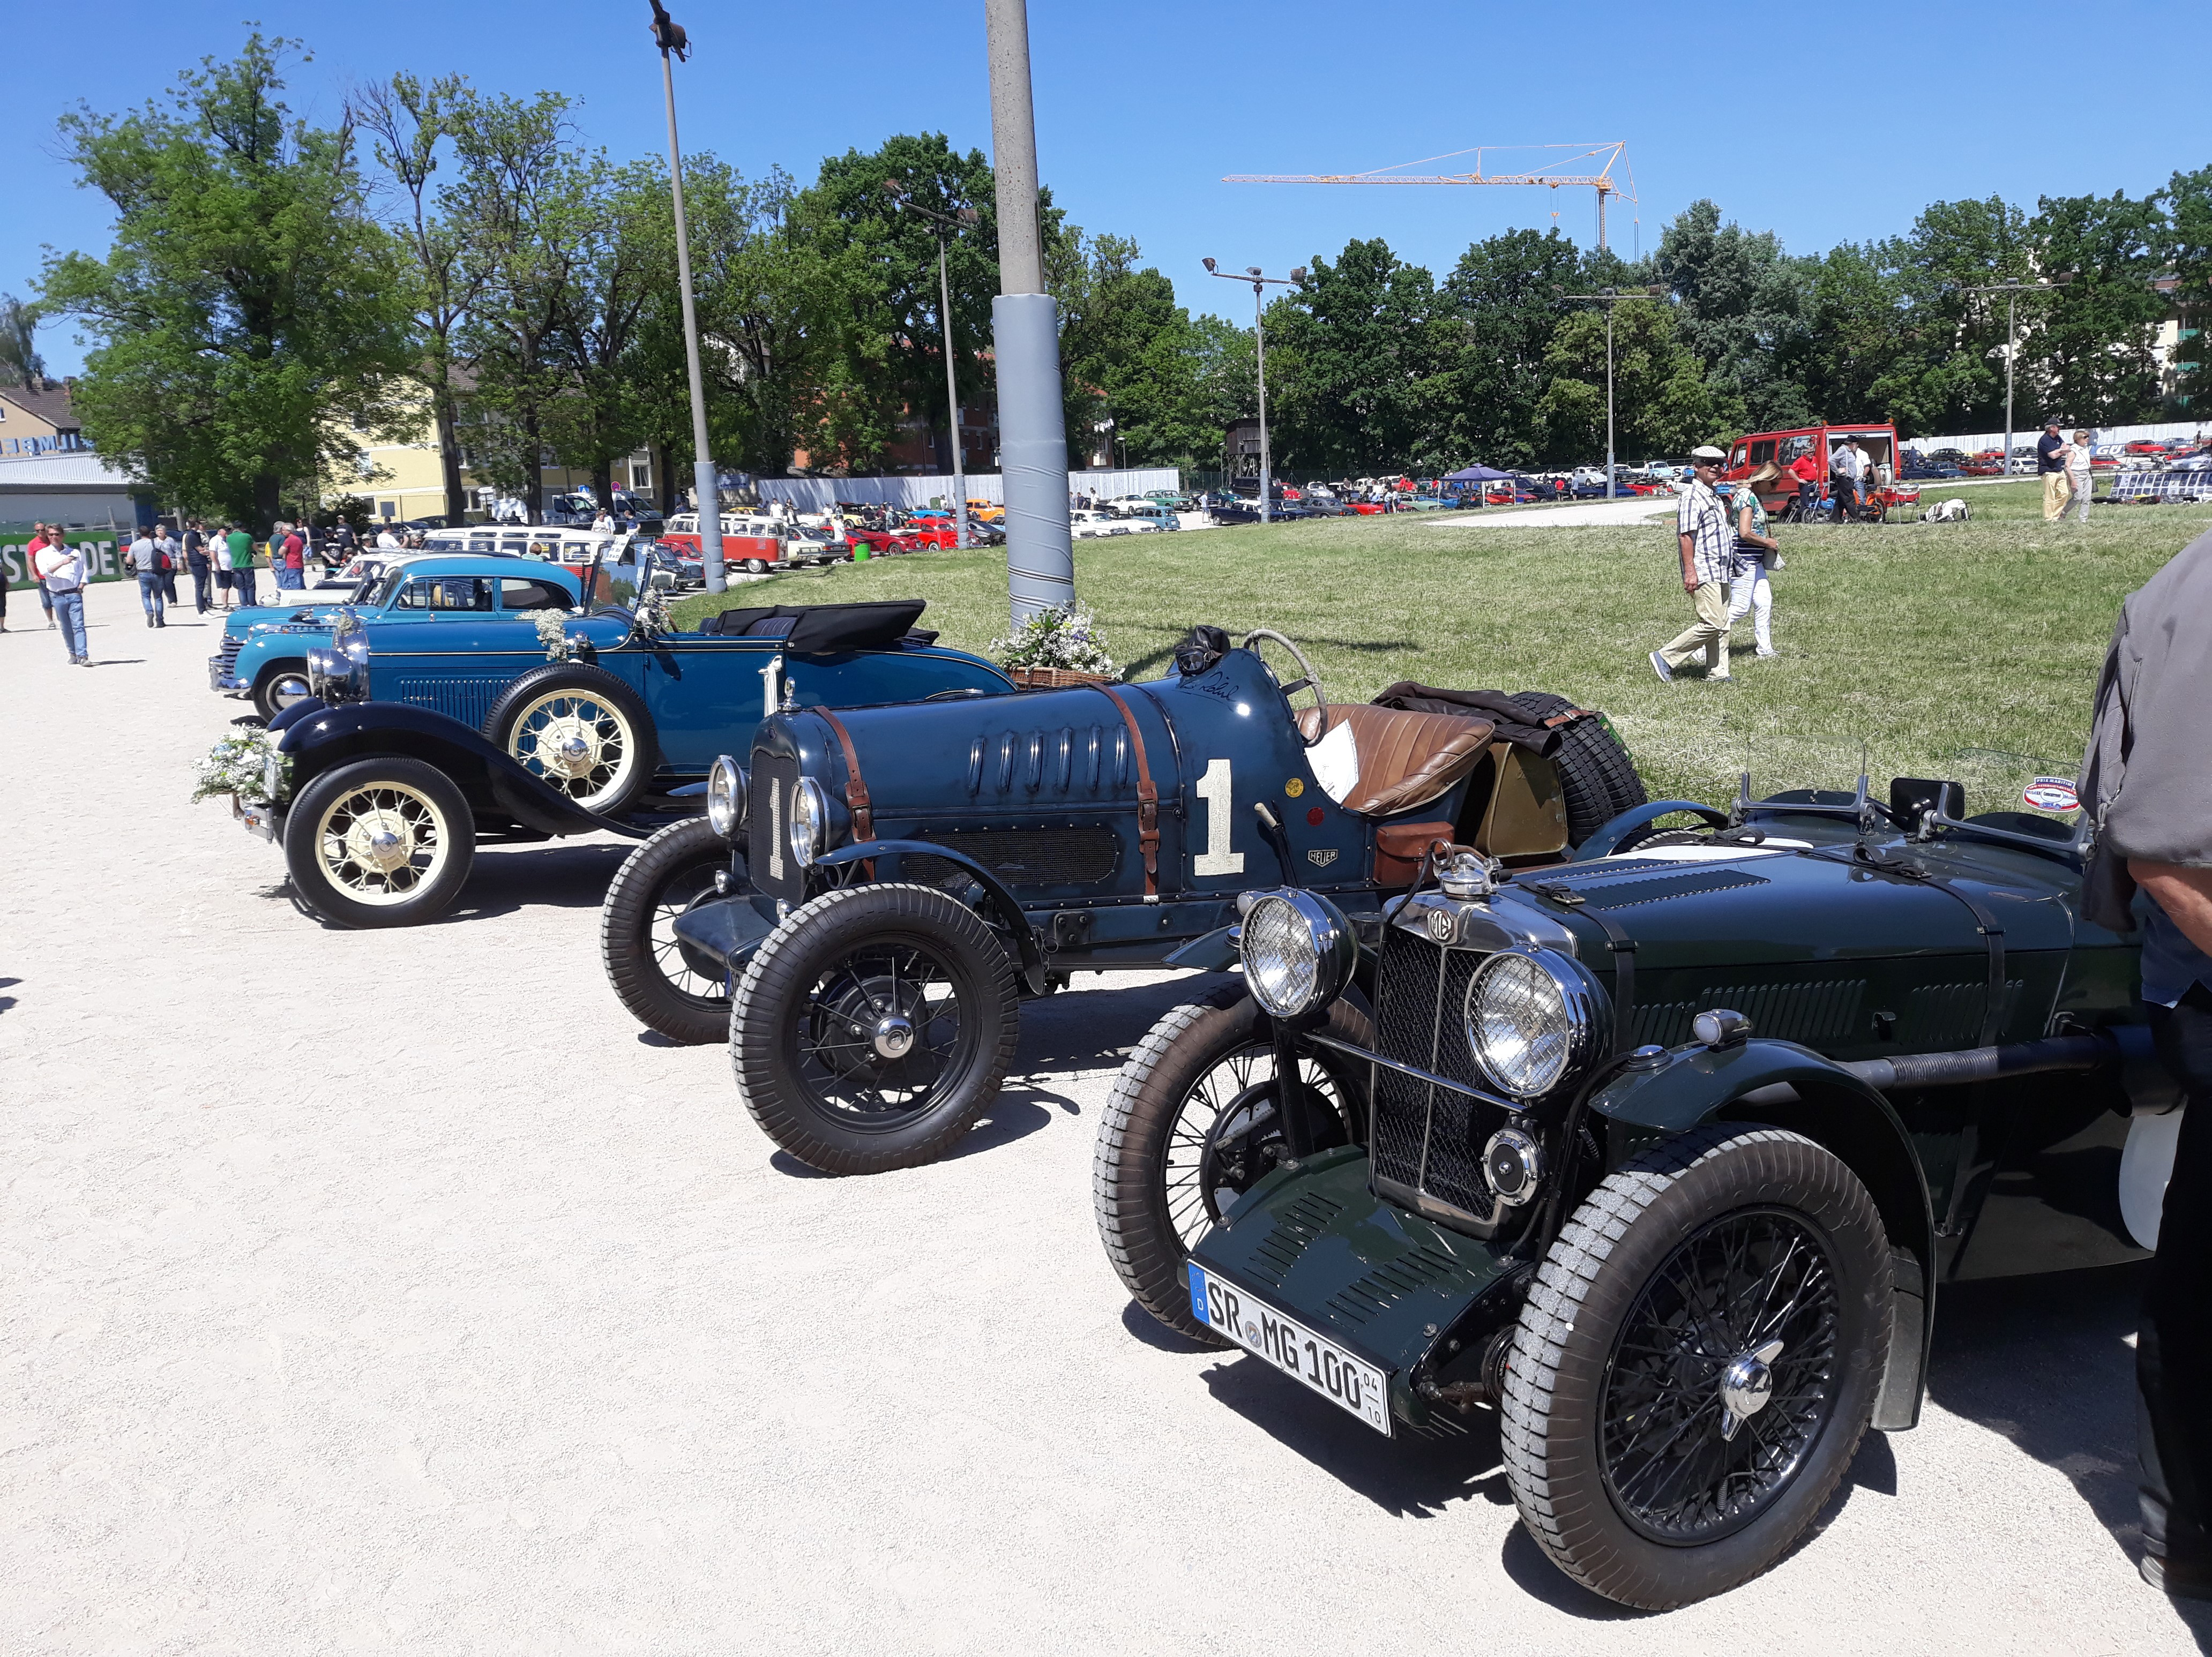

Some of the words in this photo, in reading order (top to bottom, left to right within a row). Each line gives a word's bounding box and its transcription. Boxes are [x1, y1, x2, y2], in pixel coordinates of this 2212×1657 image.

[769, 777, 783, 880] 1
[1194, 759, 1244, 876] 1
[1311, 851, 1336, 865] HEUER
[1431, 909, 1453, 941] MG
[1197, 1297, 1204, 1311] D
[1208, 1282, 1242, 1338] SR
[1261, 1311, 1299, 1373] MG
[1305, 1340, 1361, 1409] 100
[1364, 1373, 1378, 1391] 04
[1367, 1406, 1381, 1424] 10
